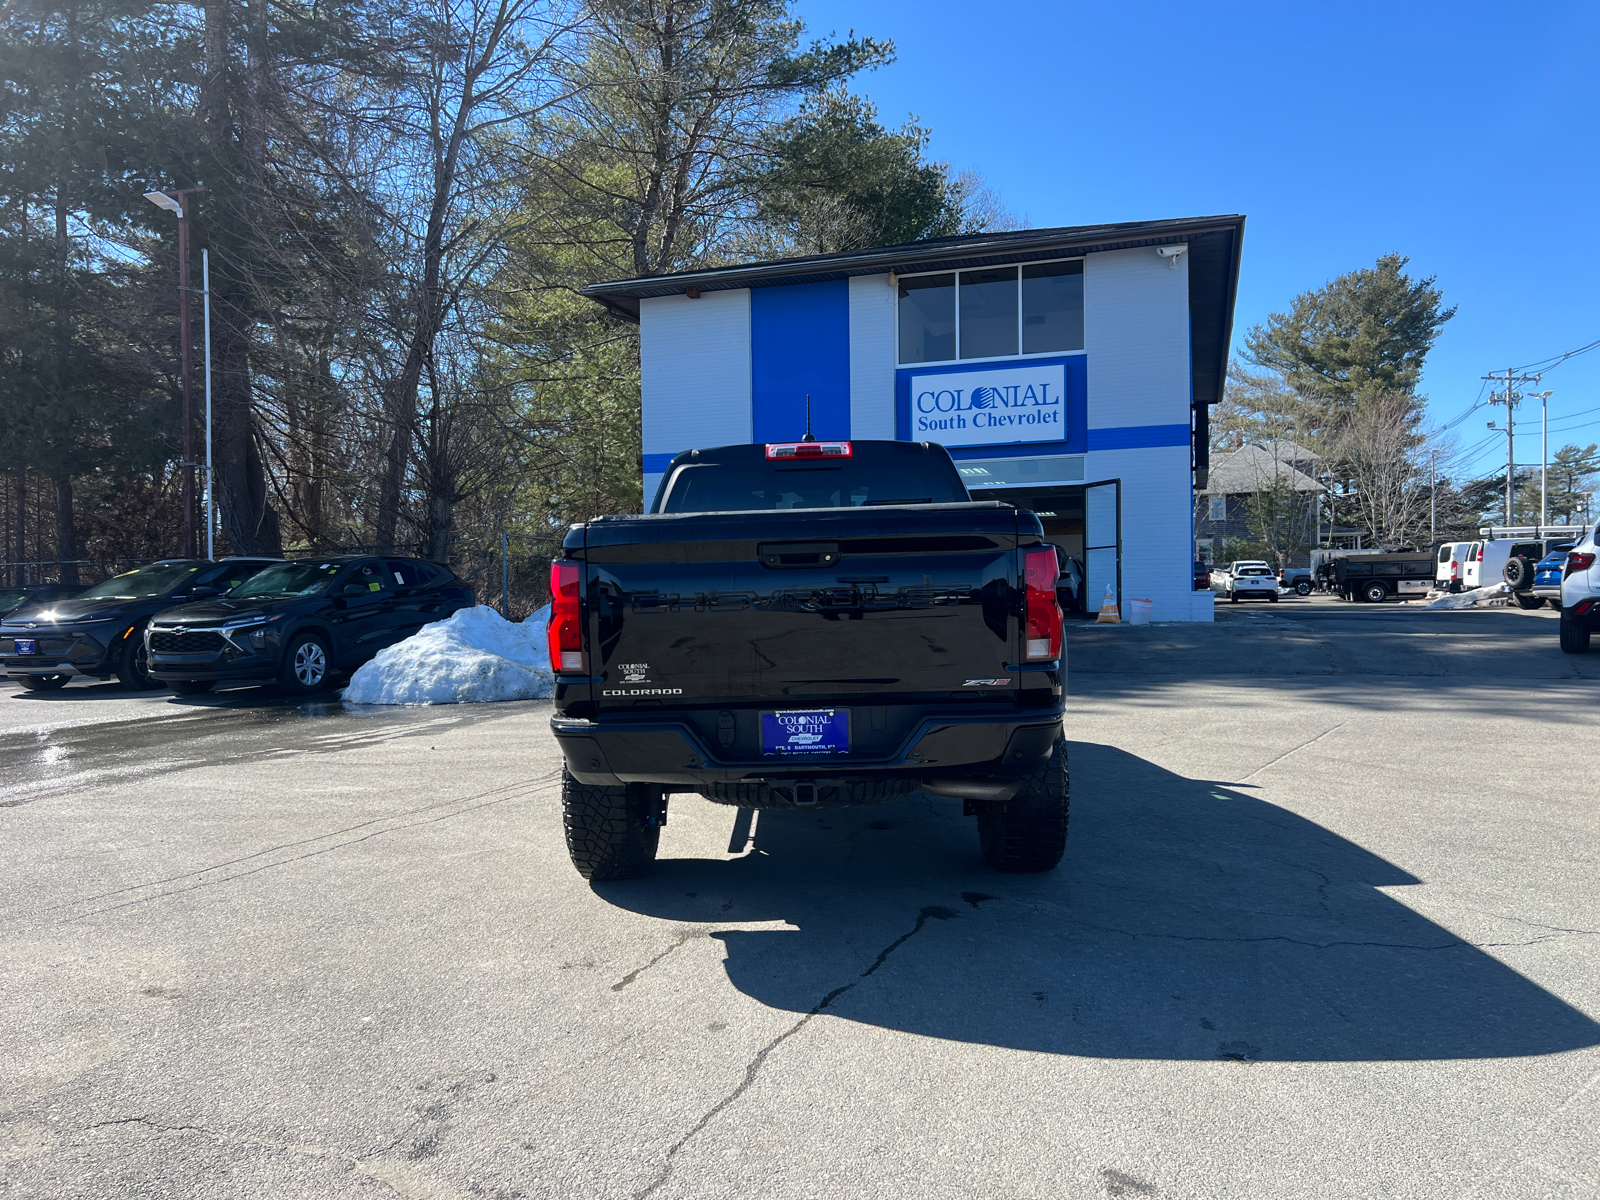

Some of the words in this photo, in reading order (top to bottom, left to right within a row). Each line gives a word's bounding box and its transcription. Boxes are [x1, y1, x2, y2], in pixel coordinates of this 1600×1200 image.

[917, 383, 1059, 413] COLONIAL
[918, 414, 967, 432] South
[972, 409, 1059, 428] Chevrolet
[962, 678, 1011, 687] ZR2
[778, 716, 831, 725] COLONIAL
[786, 724, 823, 734] SOUTH
